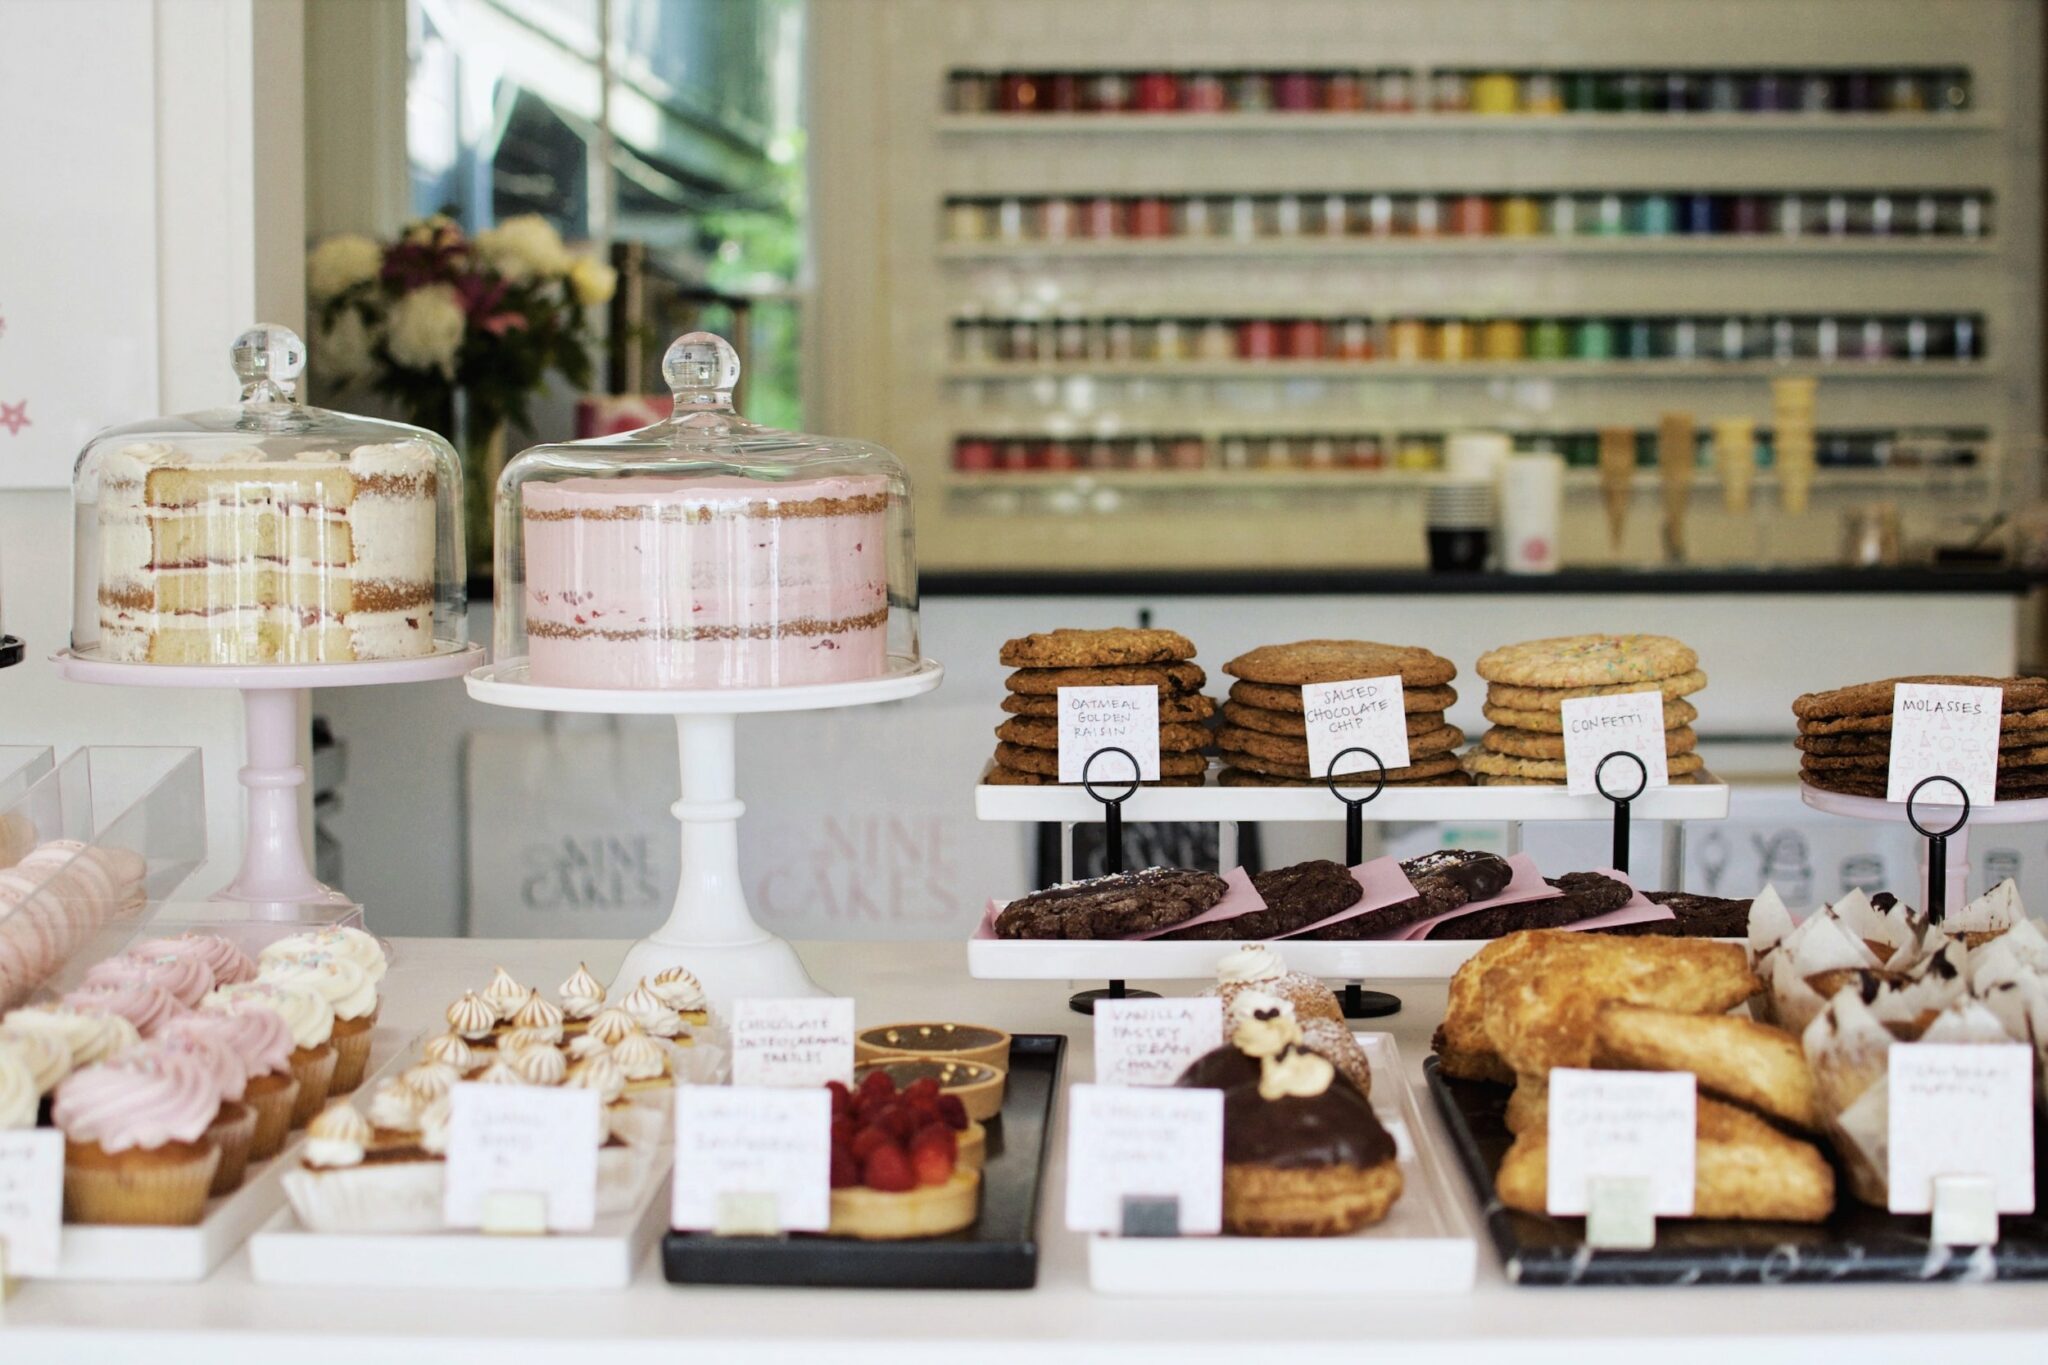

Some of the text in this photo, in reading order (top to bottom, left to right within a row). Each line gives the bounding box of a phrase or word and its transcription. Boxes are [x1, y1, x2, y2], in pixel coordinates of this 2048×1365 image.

[1324, 686, 1378, 705] SALTED
[1071, 698, 1141, 710] OATMEAL
[1902, 699, 1982, 715] MOLASSES
[1077, 712, 1131, 723] GOLDEN
[1306, 699, 1389, 723] CHOCOLATE
[1073, 726, 1126, 738] RAISIN
[1112, 1009, 1193, 1022] VANILLA
